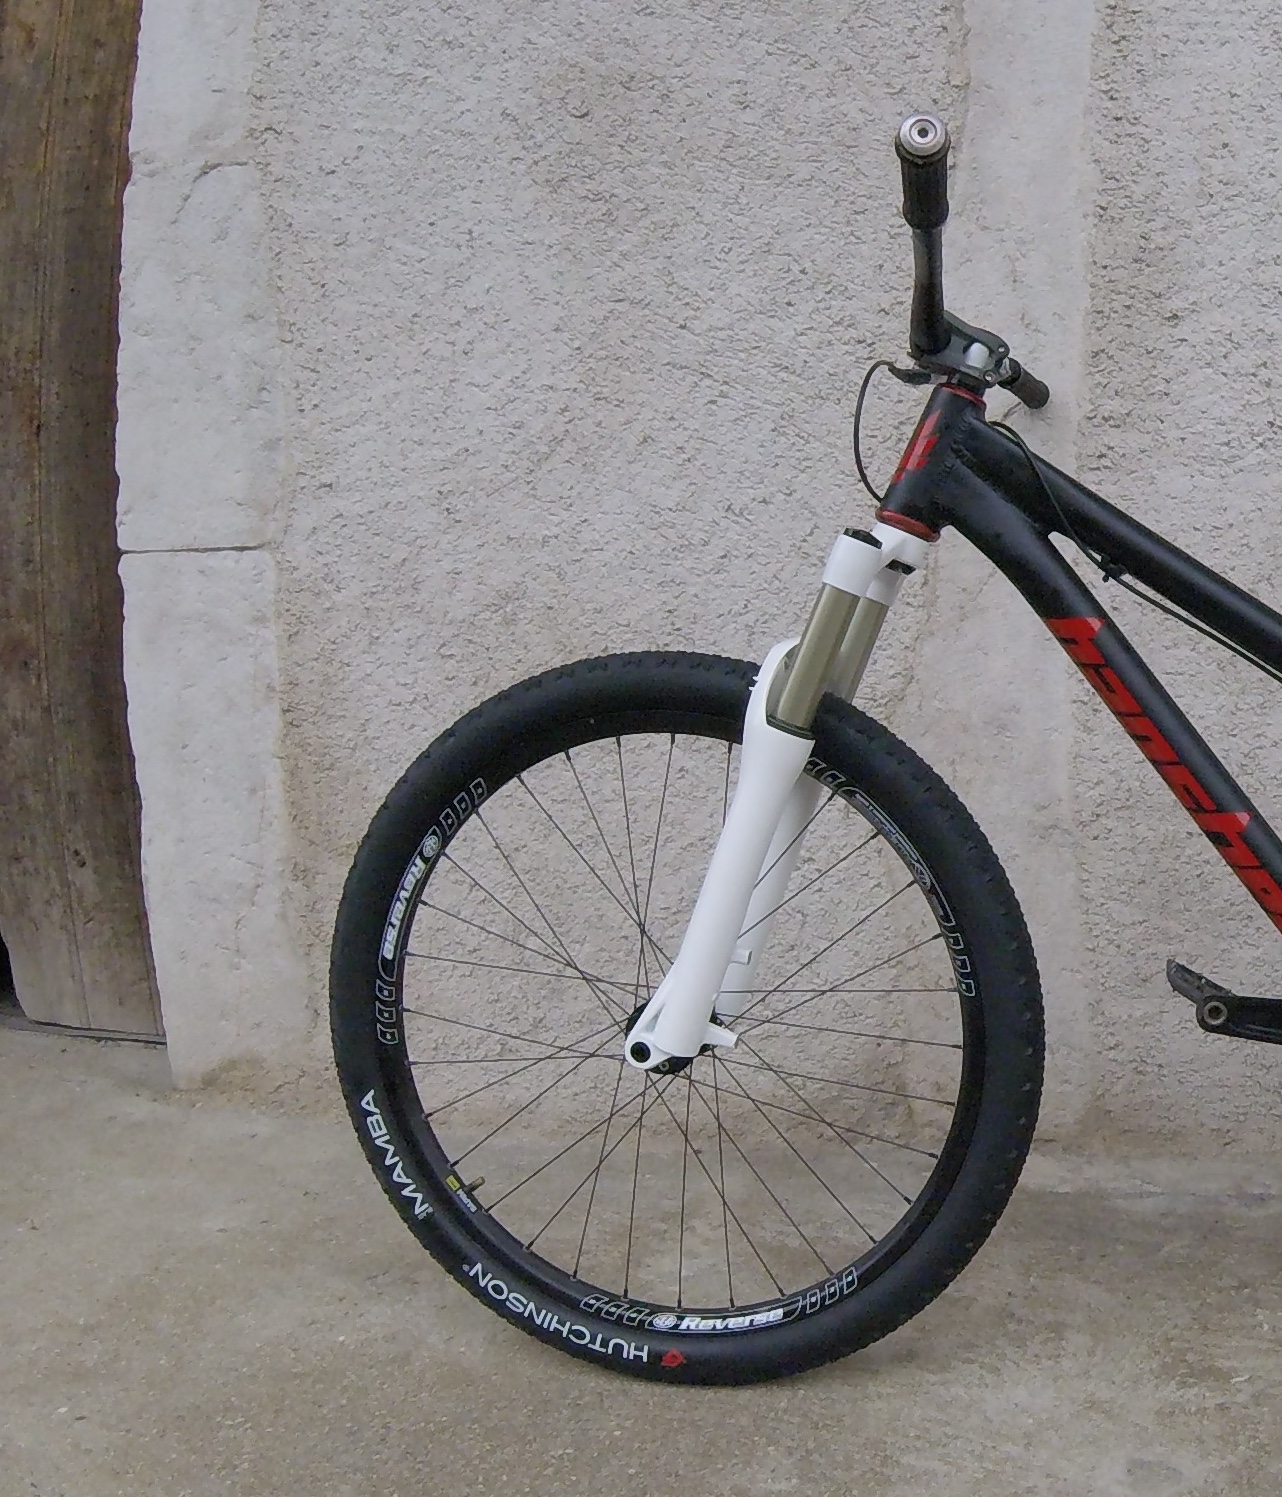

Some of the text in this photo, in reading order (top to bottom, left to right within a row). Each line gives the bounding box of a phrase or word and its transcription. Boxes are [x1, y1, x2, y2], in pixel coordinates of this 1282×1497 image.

[382, 854, 428, 961] Reverse
[360, 1089, 430, 1215] MAMBA
[468, 1262, 649, 1363] HUTCHINSON
[677, 1308, 784, 1330] Reverse
